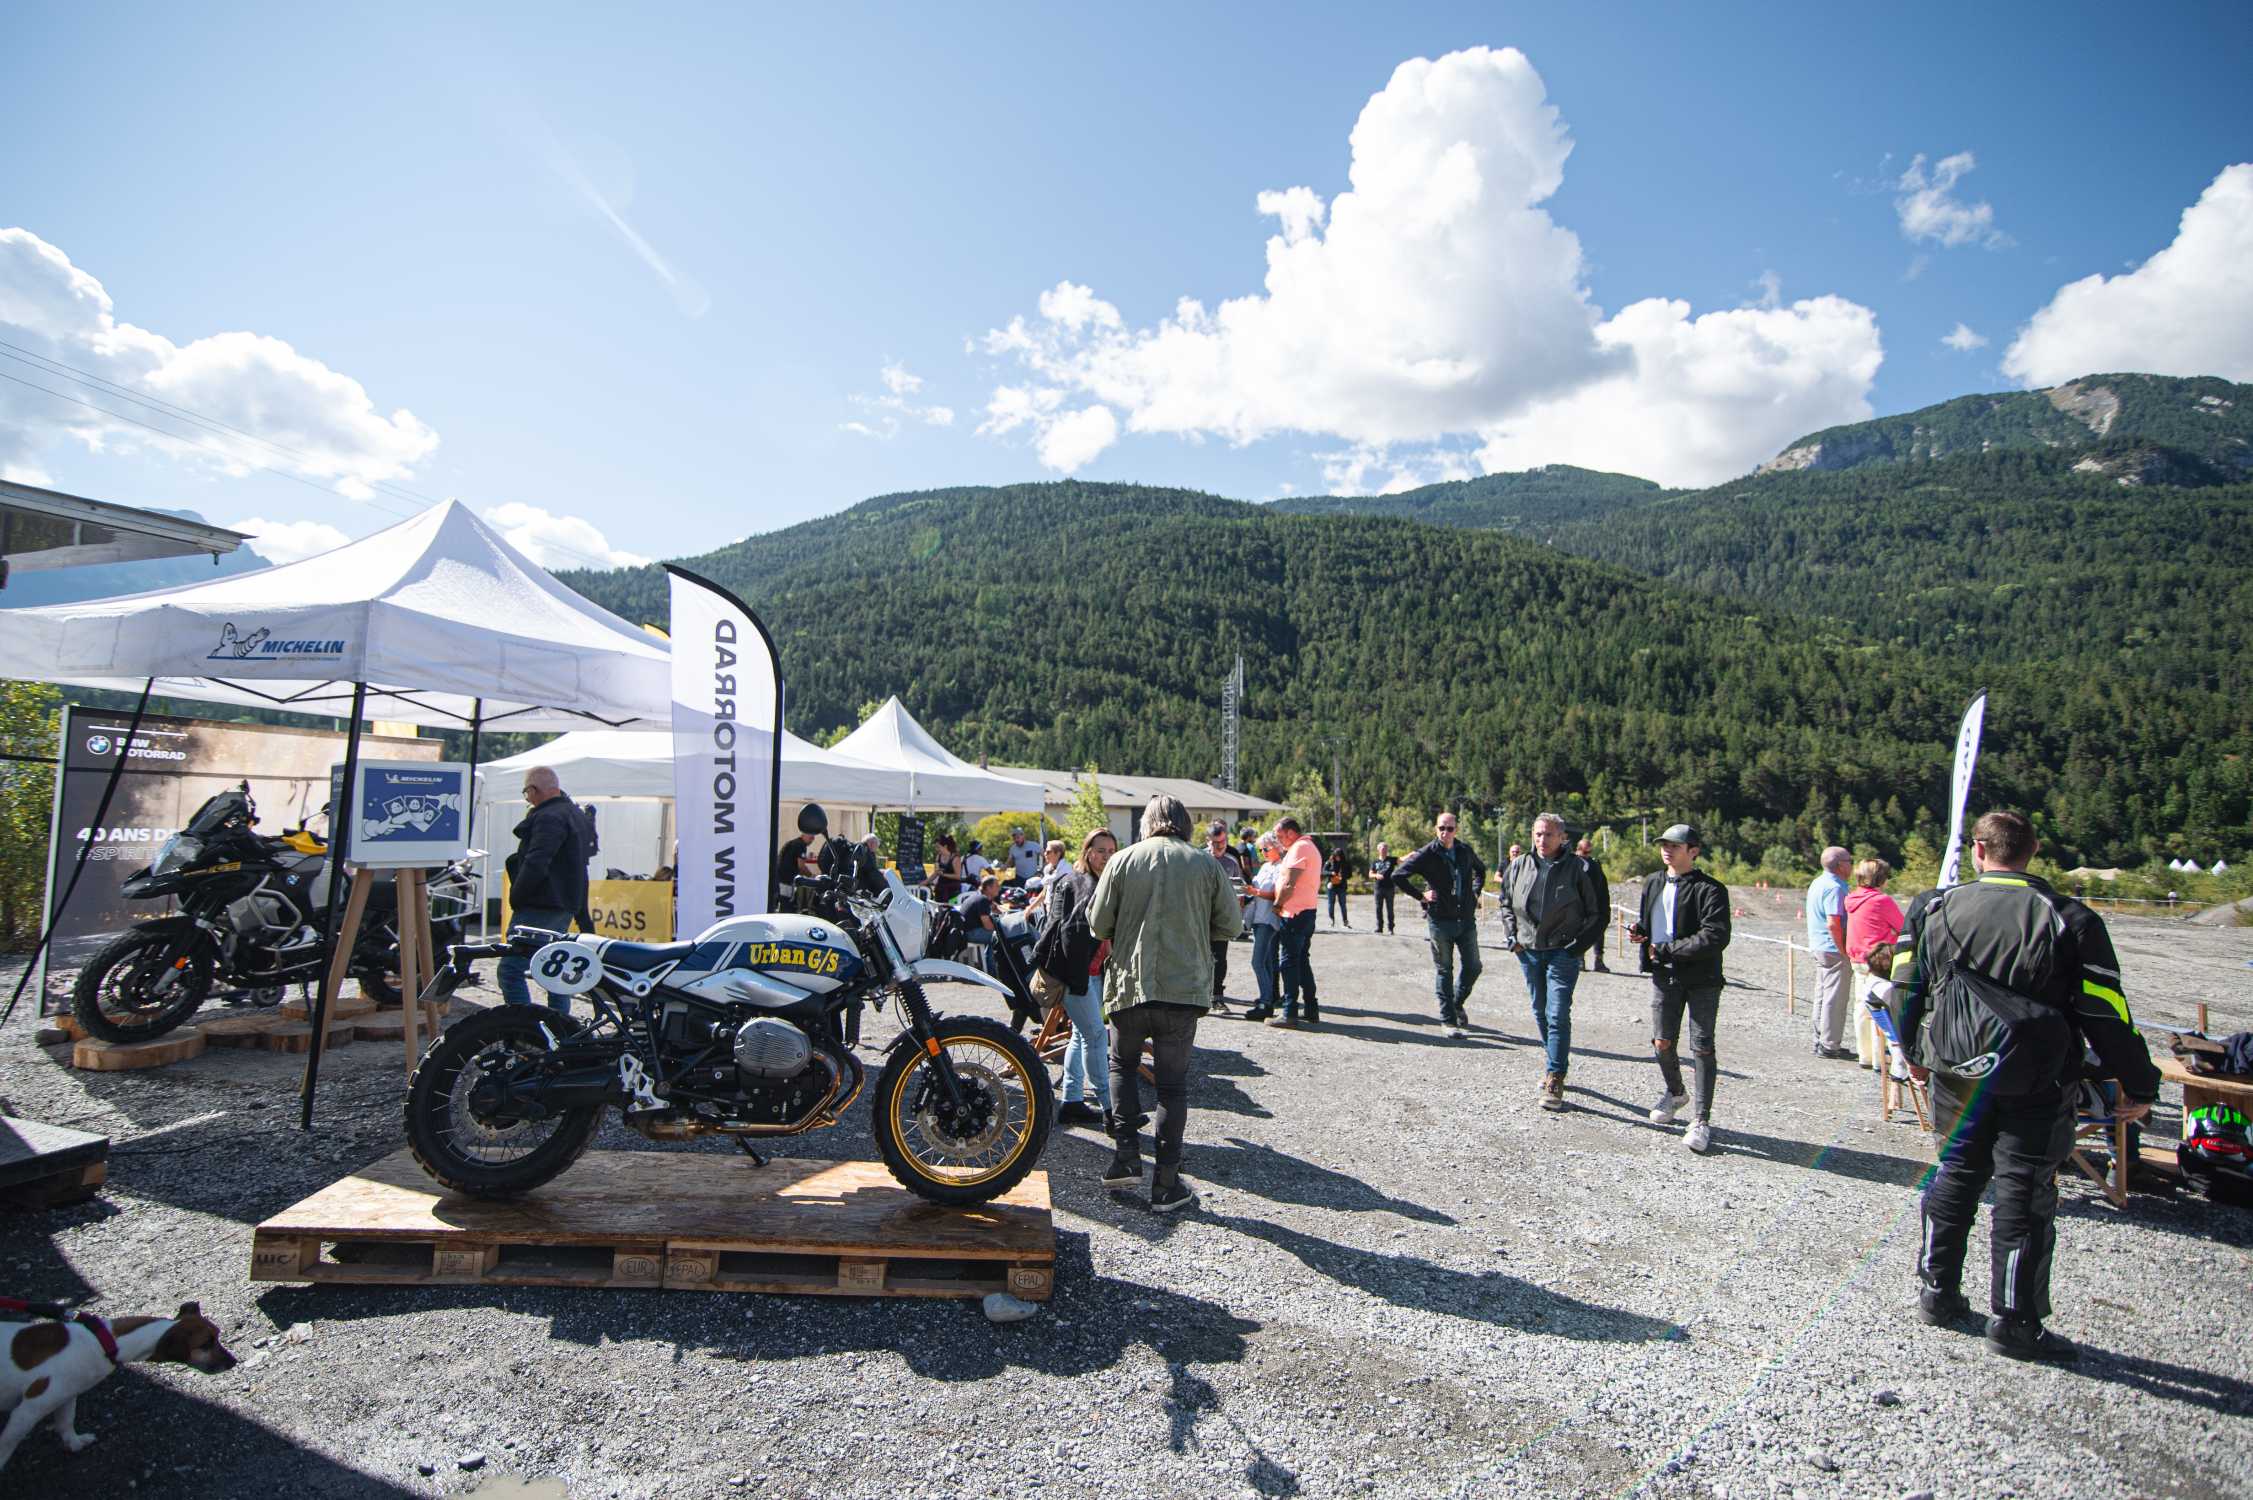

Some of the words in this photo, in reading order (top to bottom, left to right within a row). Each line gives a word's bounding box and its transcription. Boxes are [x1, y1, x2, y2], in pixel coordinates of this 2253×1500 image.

[261, 640, 345, 654] MICHELIN
[109, 827, 151, 841] ANS
[592, 908, 646, 931] PASS
[541, 949, 591, 985] 83
[750, 943, 805, 965] Urban
[807, 947, 840, 974] G/S
